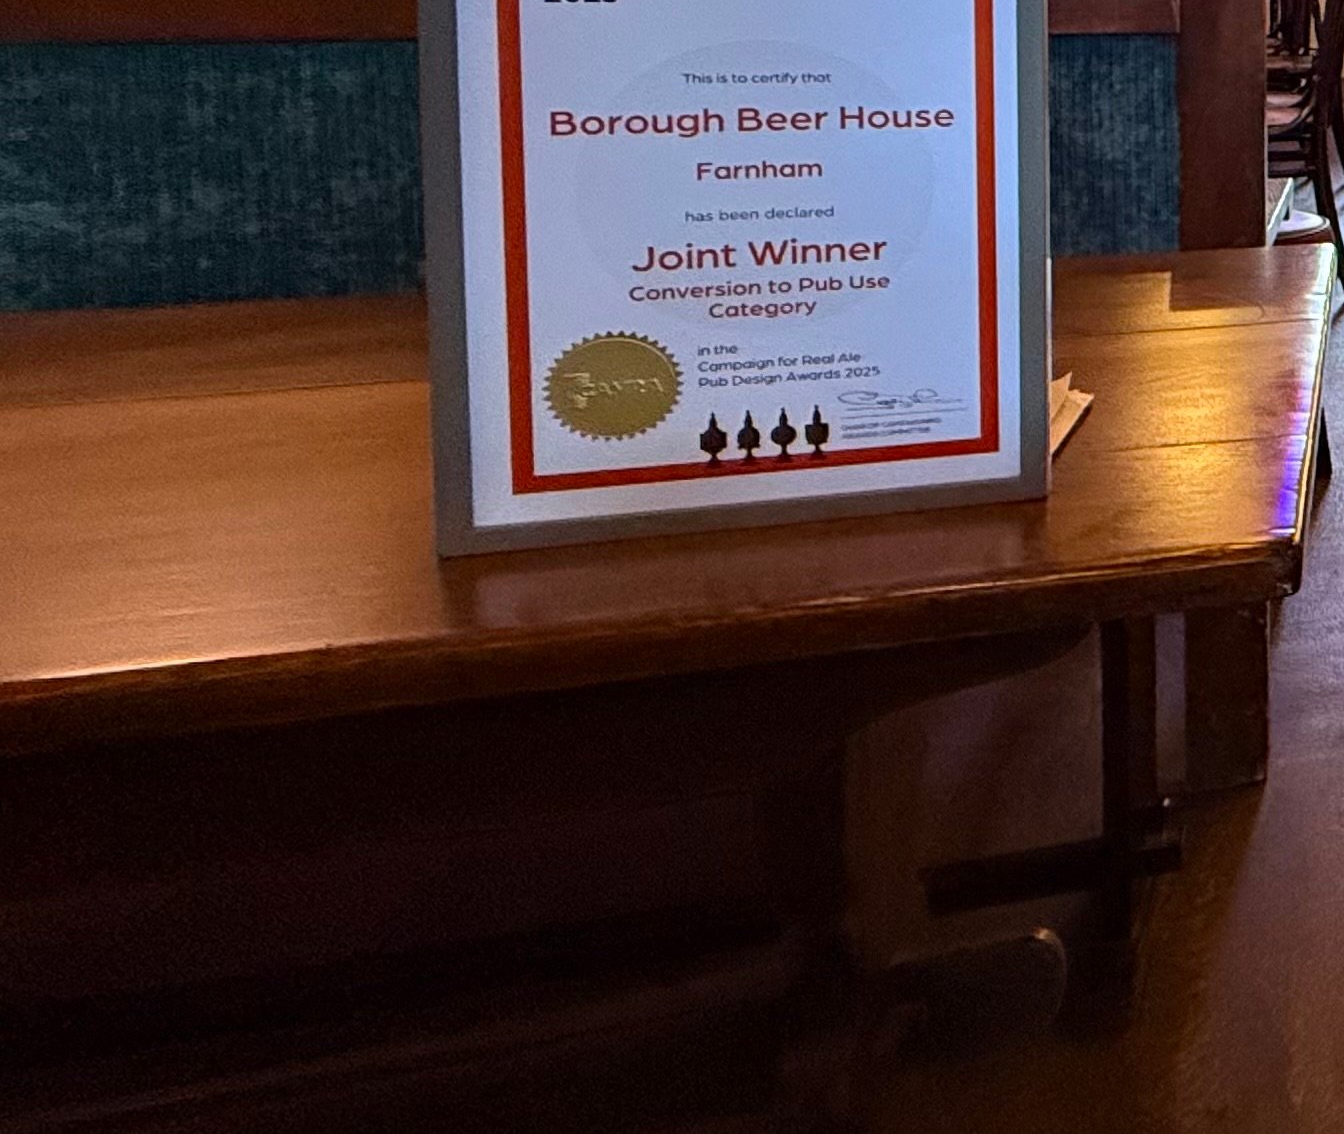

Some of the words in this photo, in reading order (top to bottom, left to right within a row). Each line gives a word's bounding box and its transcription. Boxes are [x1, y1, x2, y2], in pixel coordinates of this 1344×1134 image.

[682, 72, 713, 85] This
[716, 72, 728, 84] is
[731, 72, 748, 84] to
[750, 72, 798, 85] certify
[801, 72, 832, 84] that
[549, 107, 725, 138] Borough
[737, 107, 828, 132] Beer
[840, 106, 955, 130] House
[696, 160, 823, 181] Farnham
[685, 210, 713, 222] has
[718, 209, 759, 221] been
[764, 206, 834, 219] declared
[632, 242, 737, 272] Joint
[748, 238, 887, 266] Winner
[629, 281, 761, 302] Conversion
[768, 280, 792, 294] to
[799, 277, 842, 293] Pub
[849, 275, 890, 289] Use
[709, 300, 817, 319] Category
[697, 345, 711, 356] in
[714, 344, 738, 355] the
[697, 359, 775, 372] Campaign
[778, 356, 798, 367] for
[802, 354, 834, 365] Real
[837, 353, 861, 364] Ale
[698, 376, 728, 387] Pub
[732, 374, 782, 386] Design
[786, 368, 841, 382] Awards
[844, 366, 880, 379] 2025
